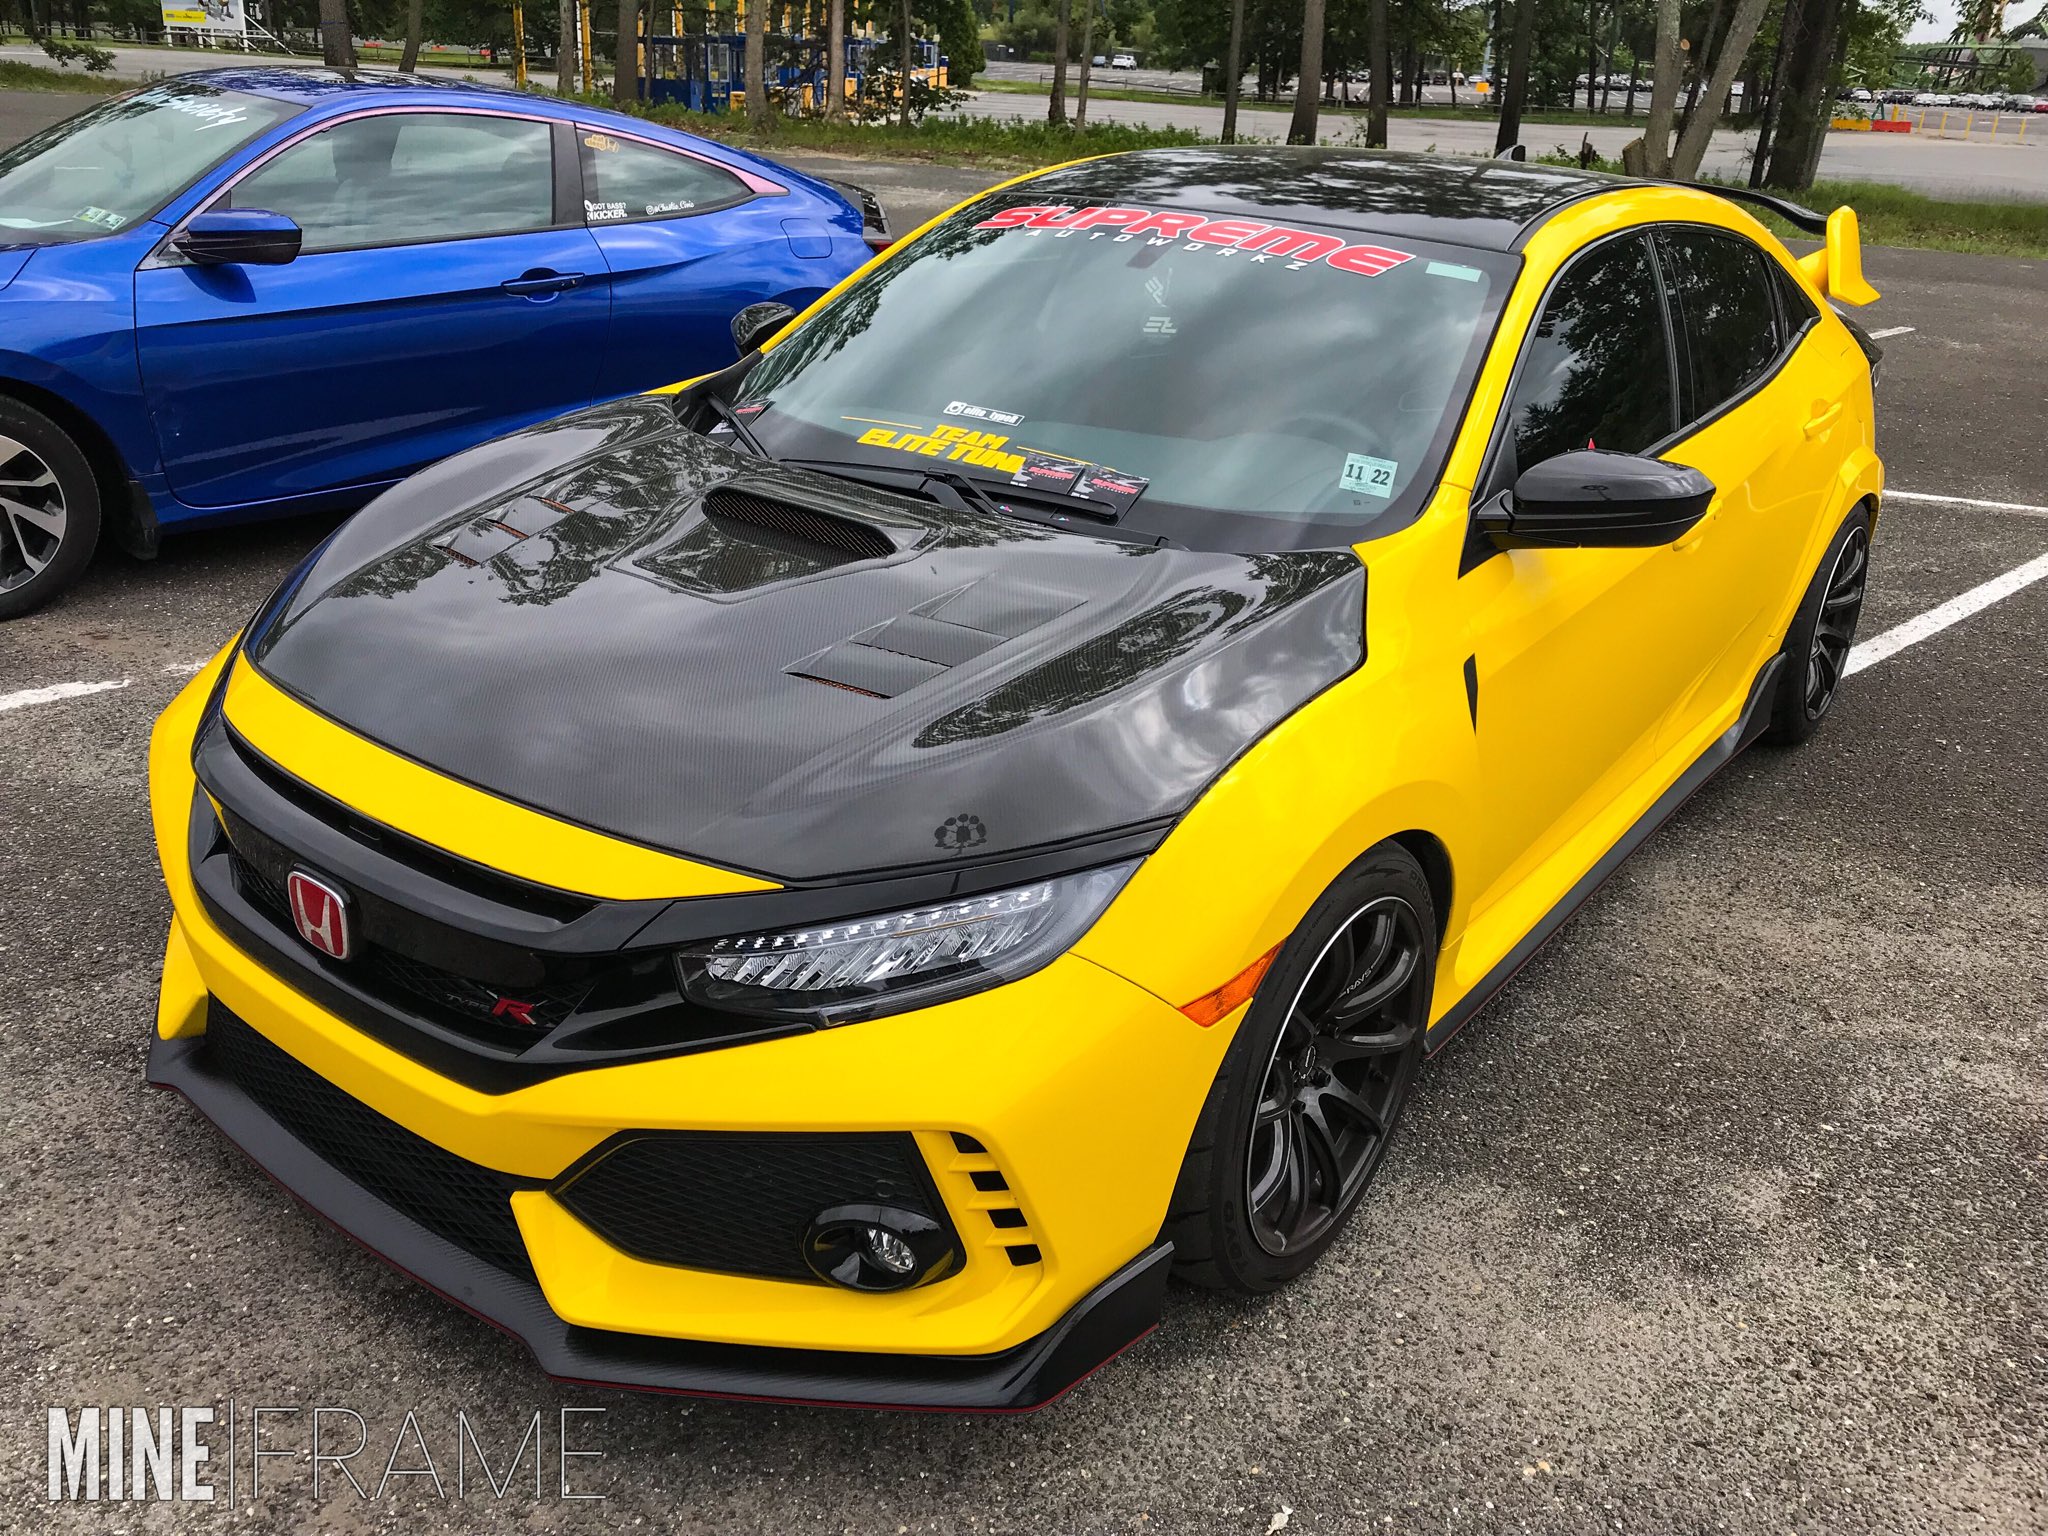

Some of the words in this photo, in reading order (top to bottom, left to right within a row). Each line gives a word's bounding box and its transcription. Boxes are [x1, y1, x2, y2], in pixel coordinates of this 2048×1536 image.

[592, 202, 606, 211] GOT
[606, 201, 627, 210] BASS?
[593, 209, 626, 221] KICKER
[972, 206, 1417, 277] SUPREME
[1025, 228, 1311, 271] AUTOWORKZ
[856, 427, 952, 457] ELITE
[929, 423, 1010, 450] TEAM
[1345, 463, 1364, 481] 11
[1370, 468, 1390, 487] 22
[1346, 967, 1372, 994] RAYS
[491, 997, 537, 1025] R
